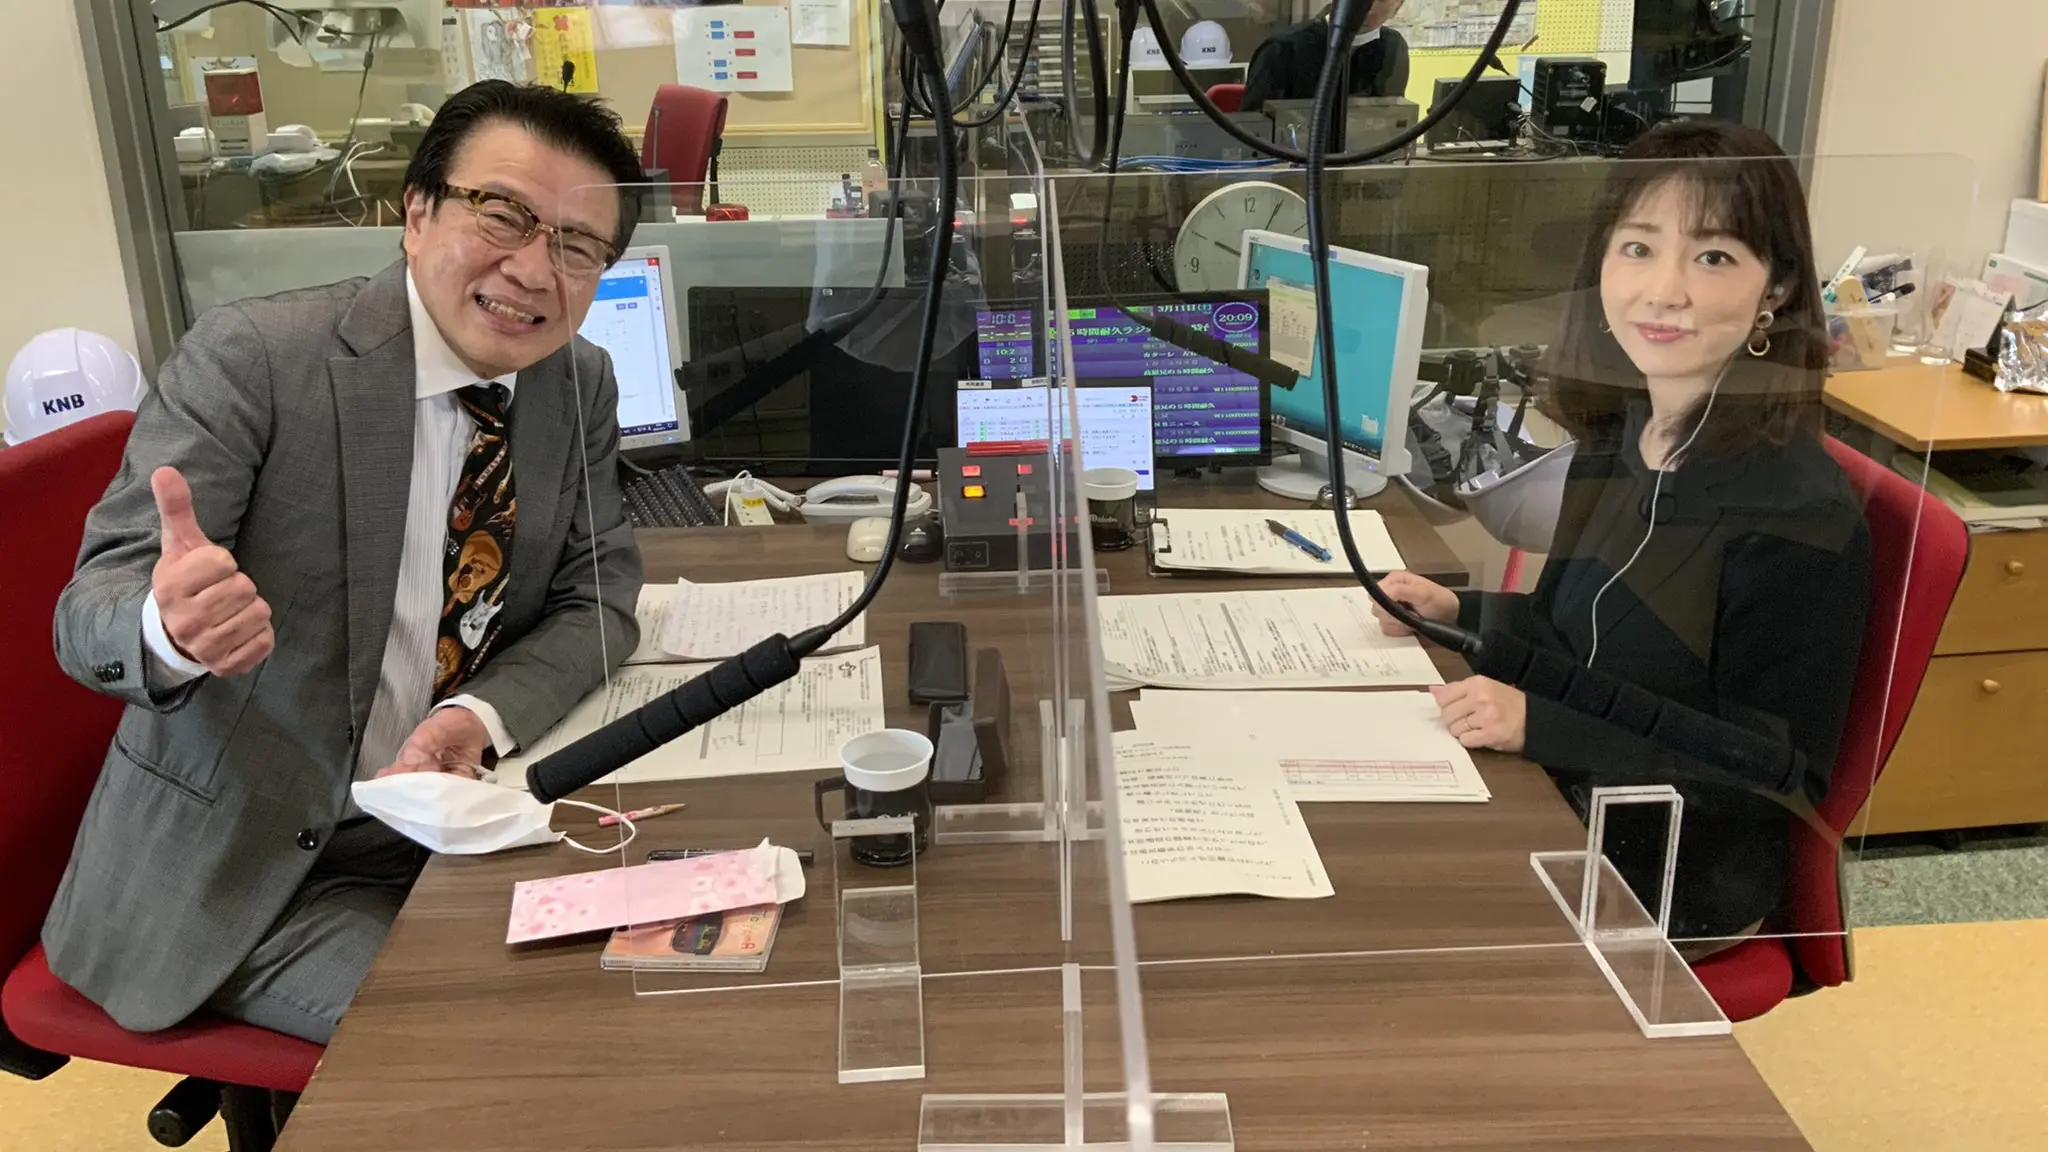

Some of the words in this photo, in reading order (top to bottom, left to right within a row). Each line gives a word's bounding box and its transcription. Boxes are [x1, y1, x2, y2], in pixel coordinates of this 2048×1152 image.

[1244, 197, 1256, 213] 12
[1191, 257, 1200, 273] 9
[1219, 312, 1253, 323] 20:09
[42, 393, 85, 416] KNB
